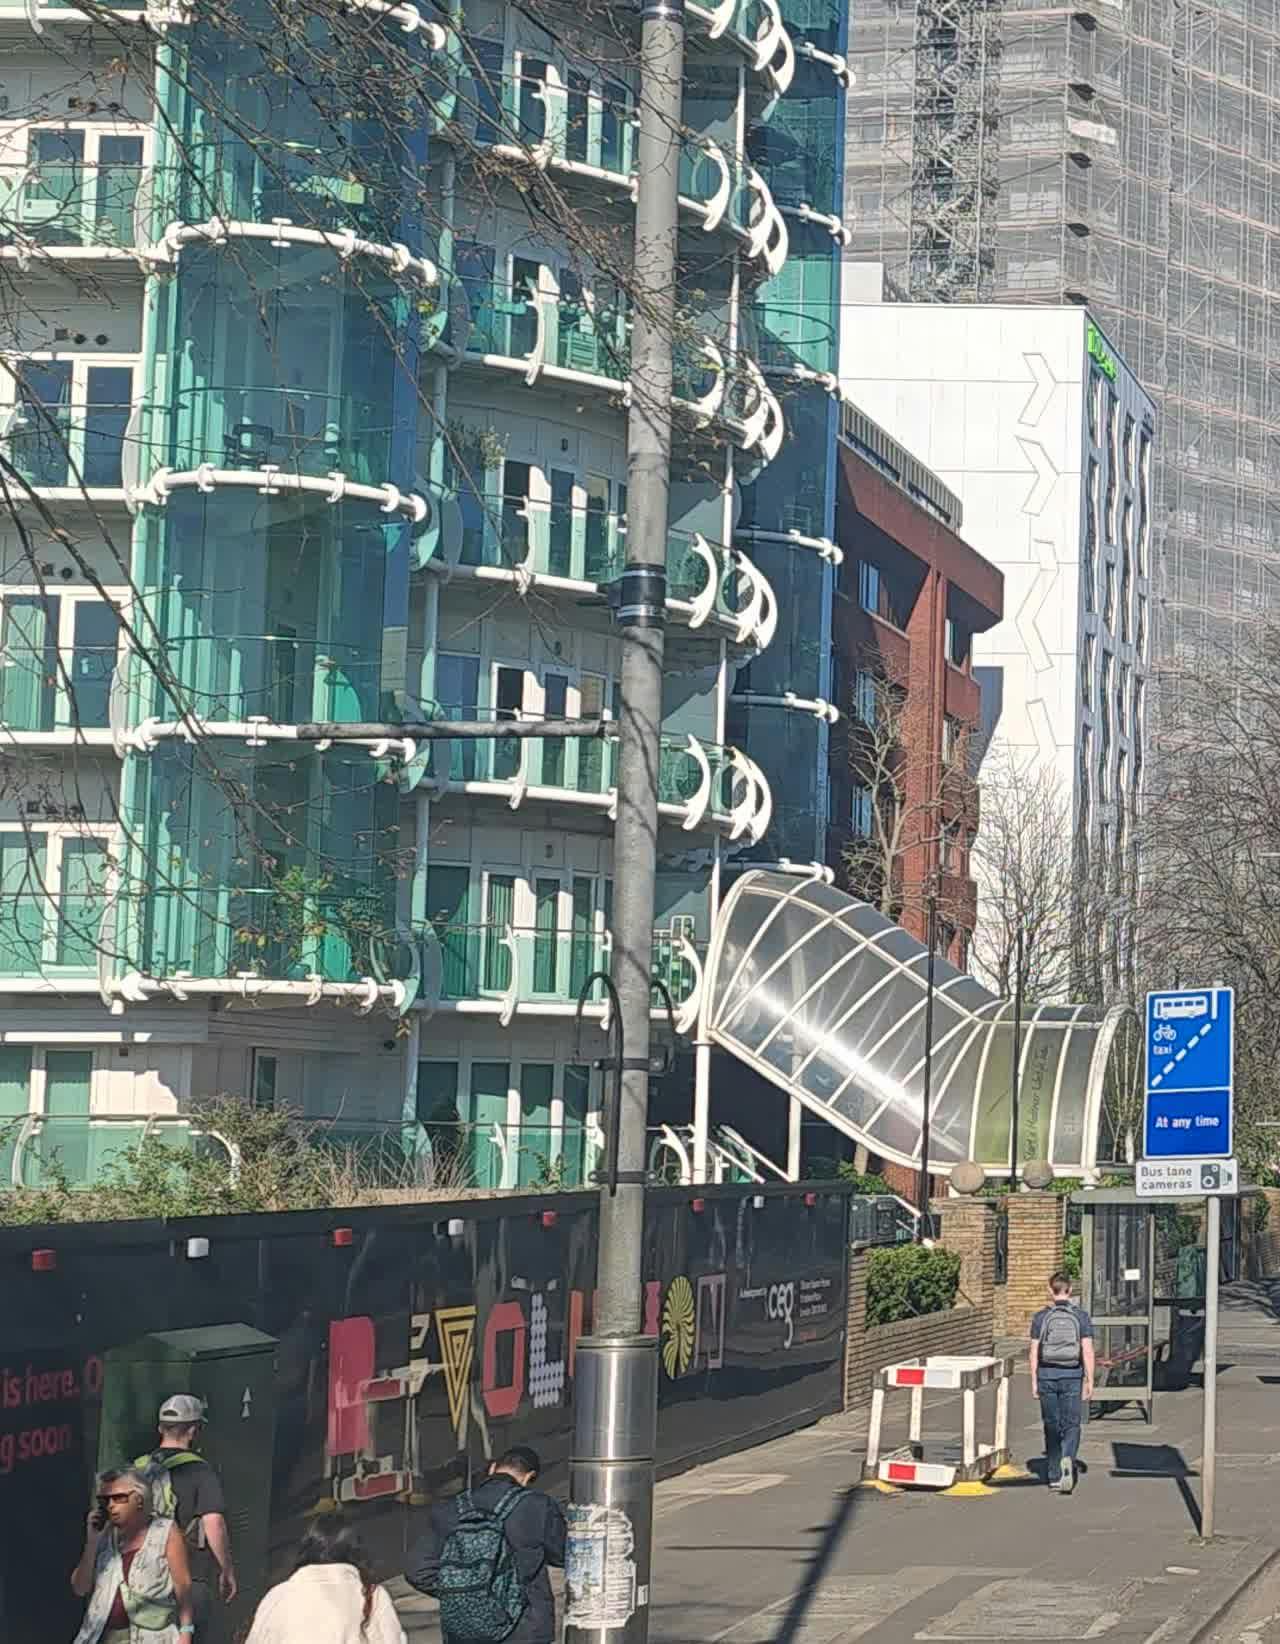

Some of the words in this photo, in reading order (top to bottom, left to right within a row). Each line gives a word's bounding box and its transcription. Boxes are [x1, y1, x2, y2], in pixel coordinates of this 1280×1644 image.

[1153, 1045, 1172, 1055] taxi
[1155, 1116, 1169, 1128] At
[1172, 1117, 1192, 1129] any
[1195, 1114, 1220, 1127] time
[1141, 1167, 1163, 1177] Bus
[1167, 1166, 1192, 1176] lane
[1142, 1179, 1193, 1190] cameras
[768, 1282, 794, 1349] ceg
[18, 1424, 72, 1459] soon
